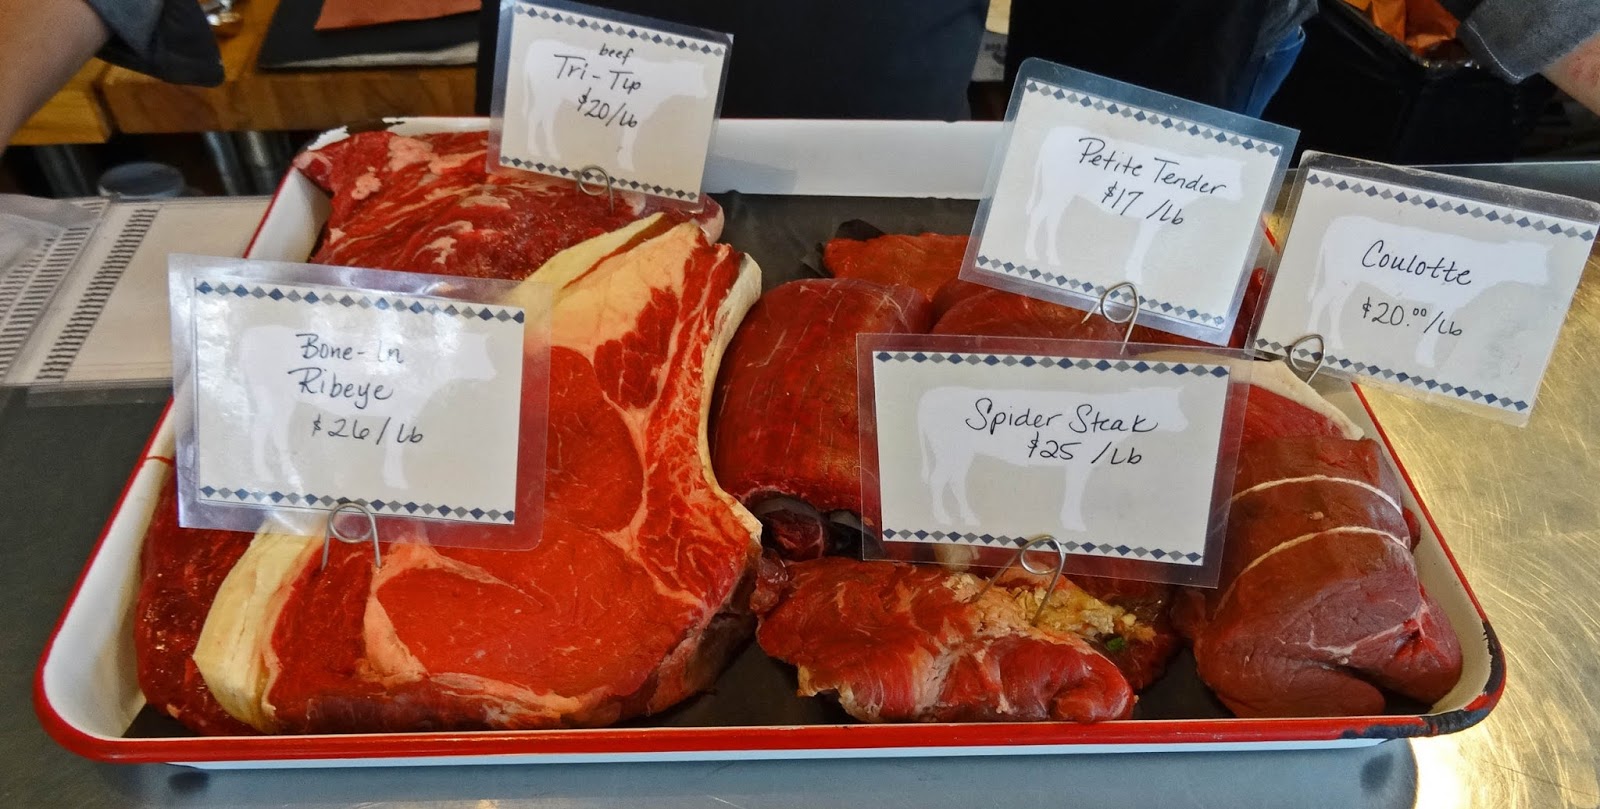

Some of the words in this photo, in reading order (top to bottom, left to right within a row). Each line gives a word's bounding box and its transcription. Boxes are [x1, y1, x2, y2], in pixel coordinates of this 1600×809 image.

[599, 43, 634, 65] beef
[1078, 137, 1143, 176] Petite
[1154, 157, 1227, 195] Tender
[1101, 181, 1144, 216] $17
[1361, 239, 1472, 286] Coulotte
[287, 367, 394, 409] Ribeye
[965, 397, 1063, 435] Spider
[1068, 404, 1158, 433] Steak
[1027, 431, 1082, 460] $25
